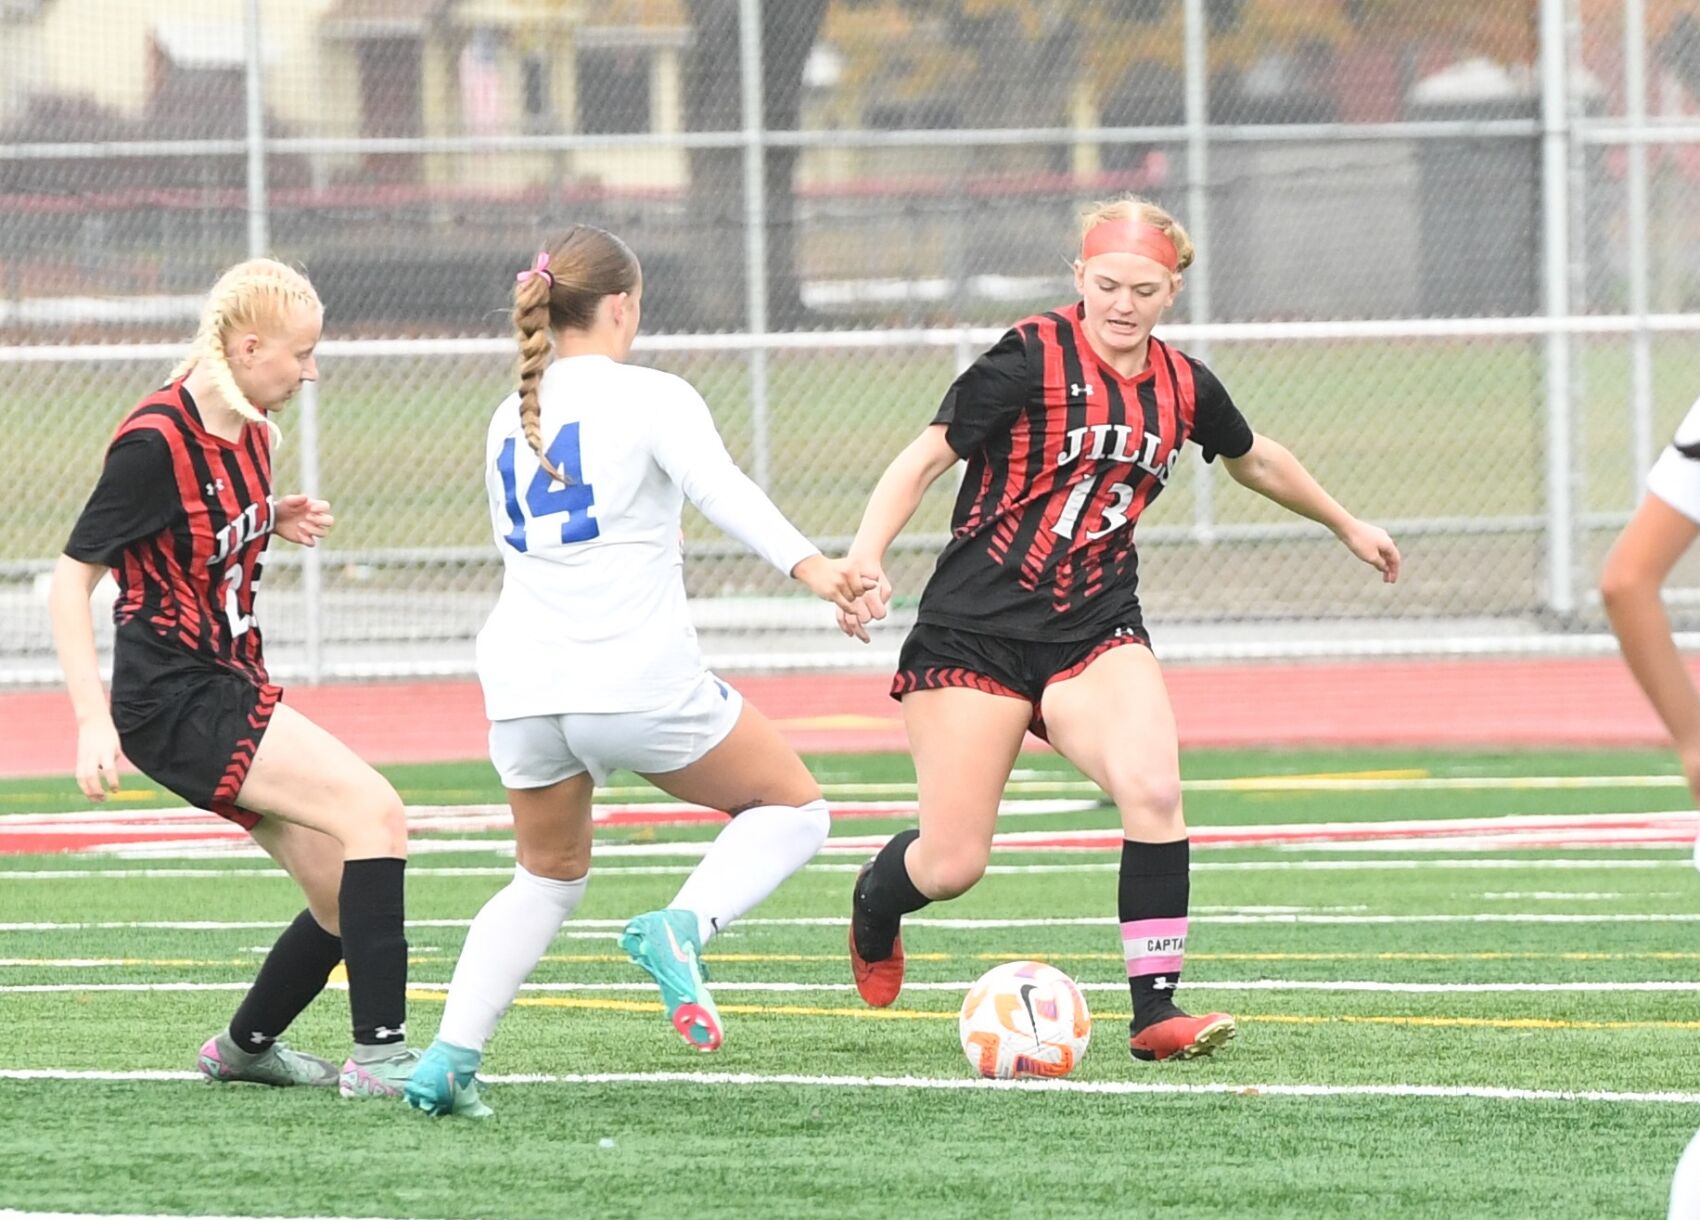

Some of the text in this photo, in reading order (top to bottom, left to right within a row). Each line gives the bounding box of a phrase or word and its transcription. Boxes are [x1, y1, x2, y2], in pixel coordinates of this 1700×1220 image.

[496, 420, 600, 553] 14
[1056, 423, 1179, 486] JILLS
[1050, 473, 1134, 540] 13
